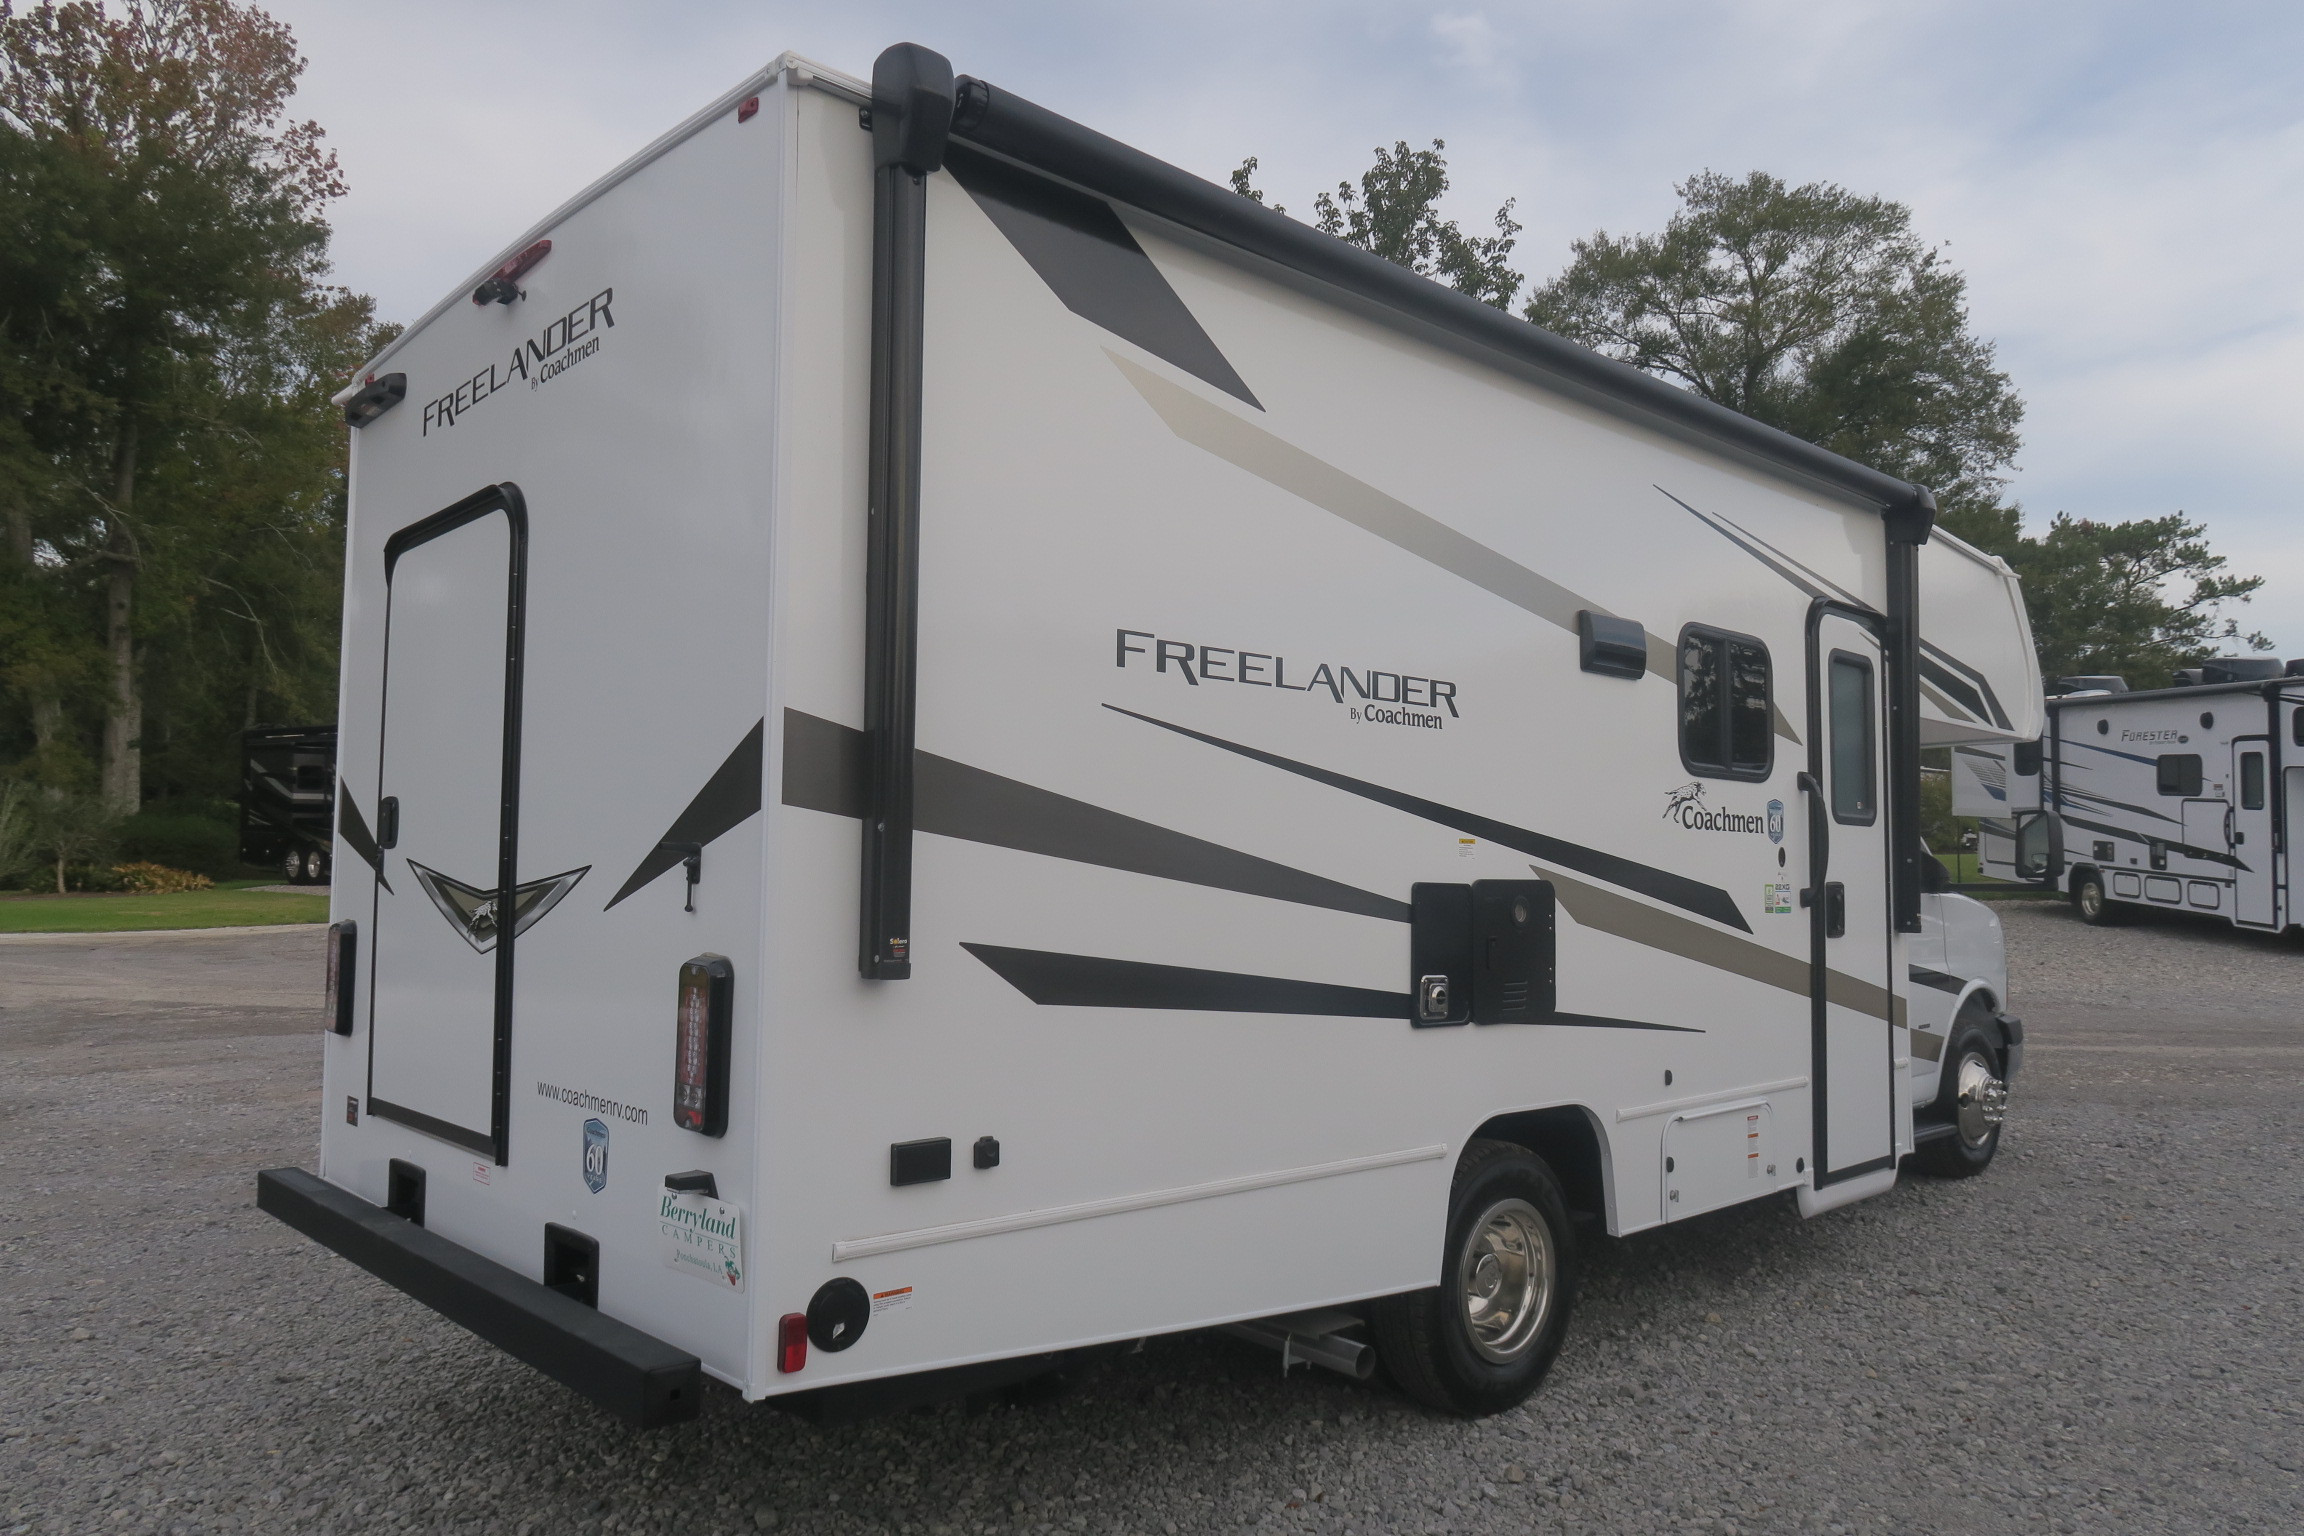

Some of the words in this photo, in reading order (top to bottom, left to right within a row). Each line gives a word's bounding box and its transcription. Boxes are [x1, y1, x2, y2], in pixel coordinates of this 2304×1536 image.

[423, 287, 615, 437] FREELANDER
[531, 377, 540, 392] By
[540, 336, 600, 384] Coachmen
[1116, 628, 1460, 719] FREELANDER
[1350, 708, 1362, 724] By
[1364, 704, 1443, 730] Coachmen
[2121, 730, 2178, 742] FORESTER
[1682, 805, 1764, 834] Coachmen
[1769, 814, 1782, 833] 60
[537, 1081, 648, 1126] www.coachmenrv.com
[586, 1143, 604, 1175] 60
[660, 1195, 736, 1240] Berryland
[662, 1224, 736, 1260] CAMPERS
